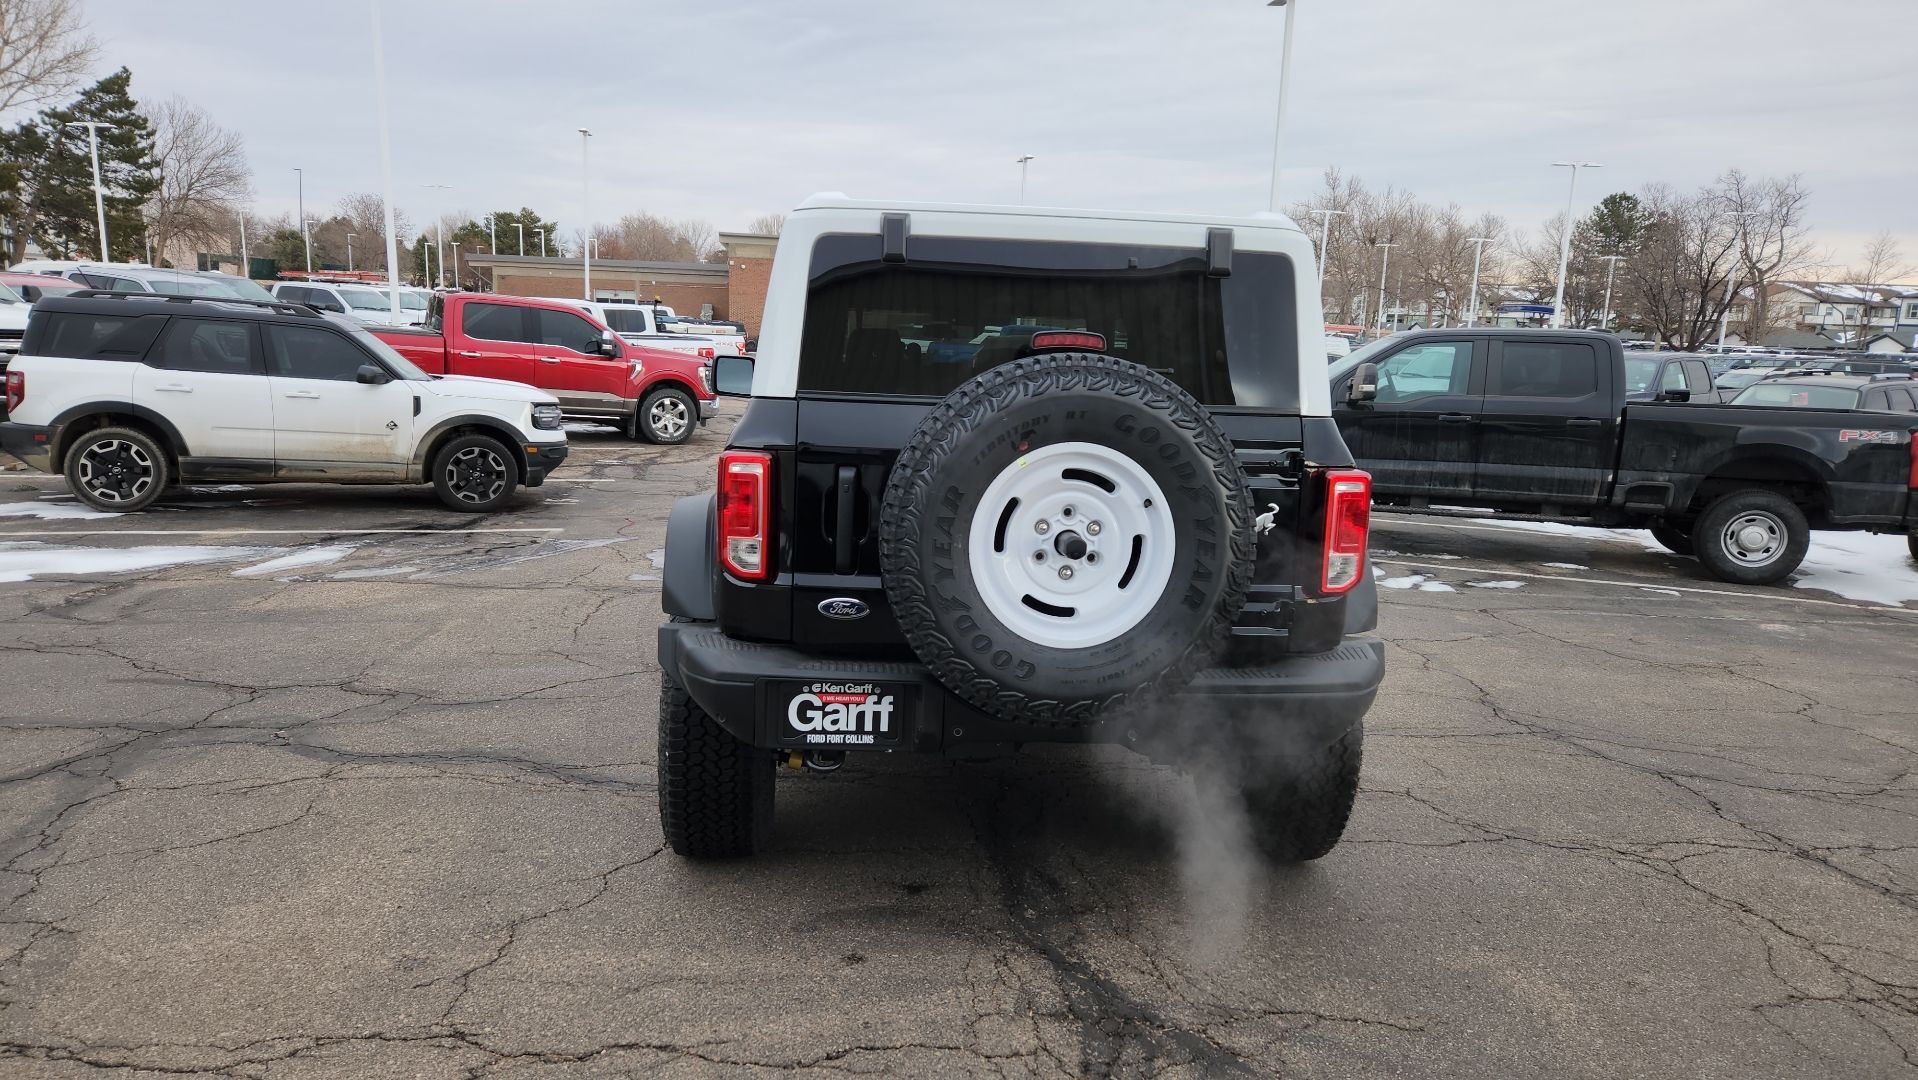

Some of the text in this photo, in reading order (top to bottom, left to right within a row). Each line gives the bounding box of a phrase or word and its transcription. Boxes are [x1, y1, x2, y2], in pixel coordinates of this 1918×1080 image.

[972, 410, 1088, 466] TERRITORY RT
[1839, 429, 1898, 442] FX4
[829, 601, 858, 615] Ford
[822, 683, 873, 694] Ken Garff
[788, 693, 894, 732] Garff
[806, 734, 874, 744] FORD FORT COLLINS
